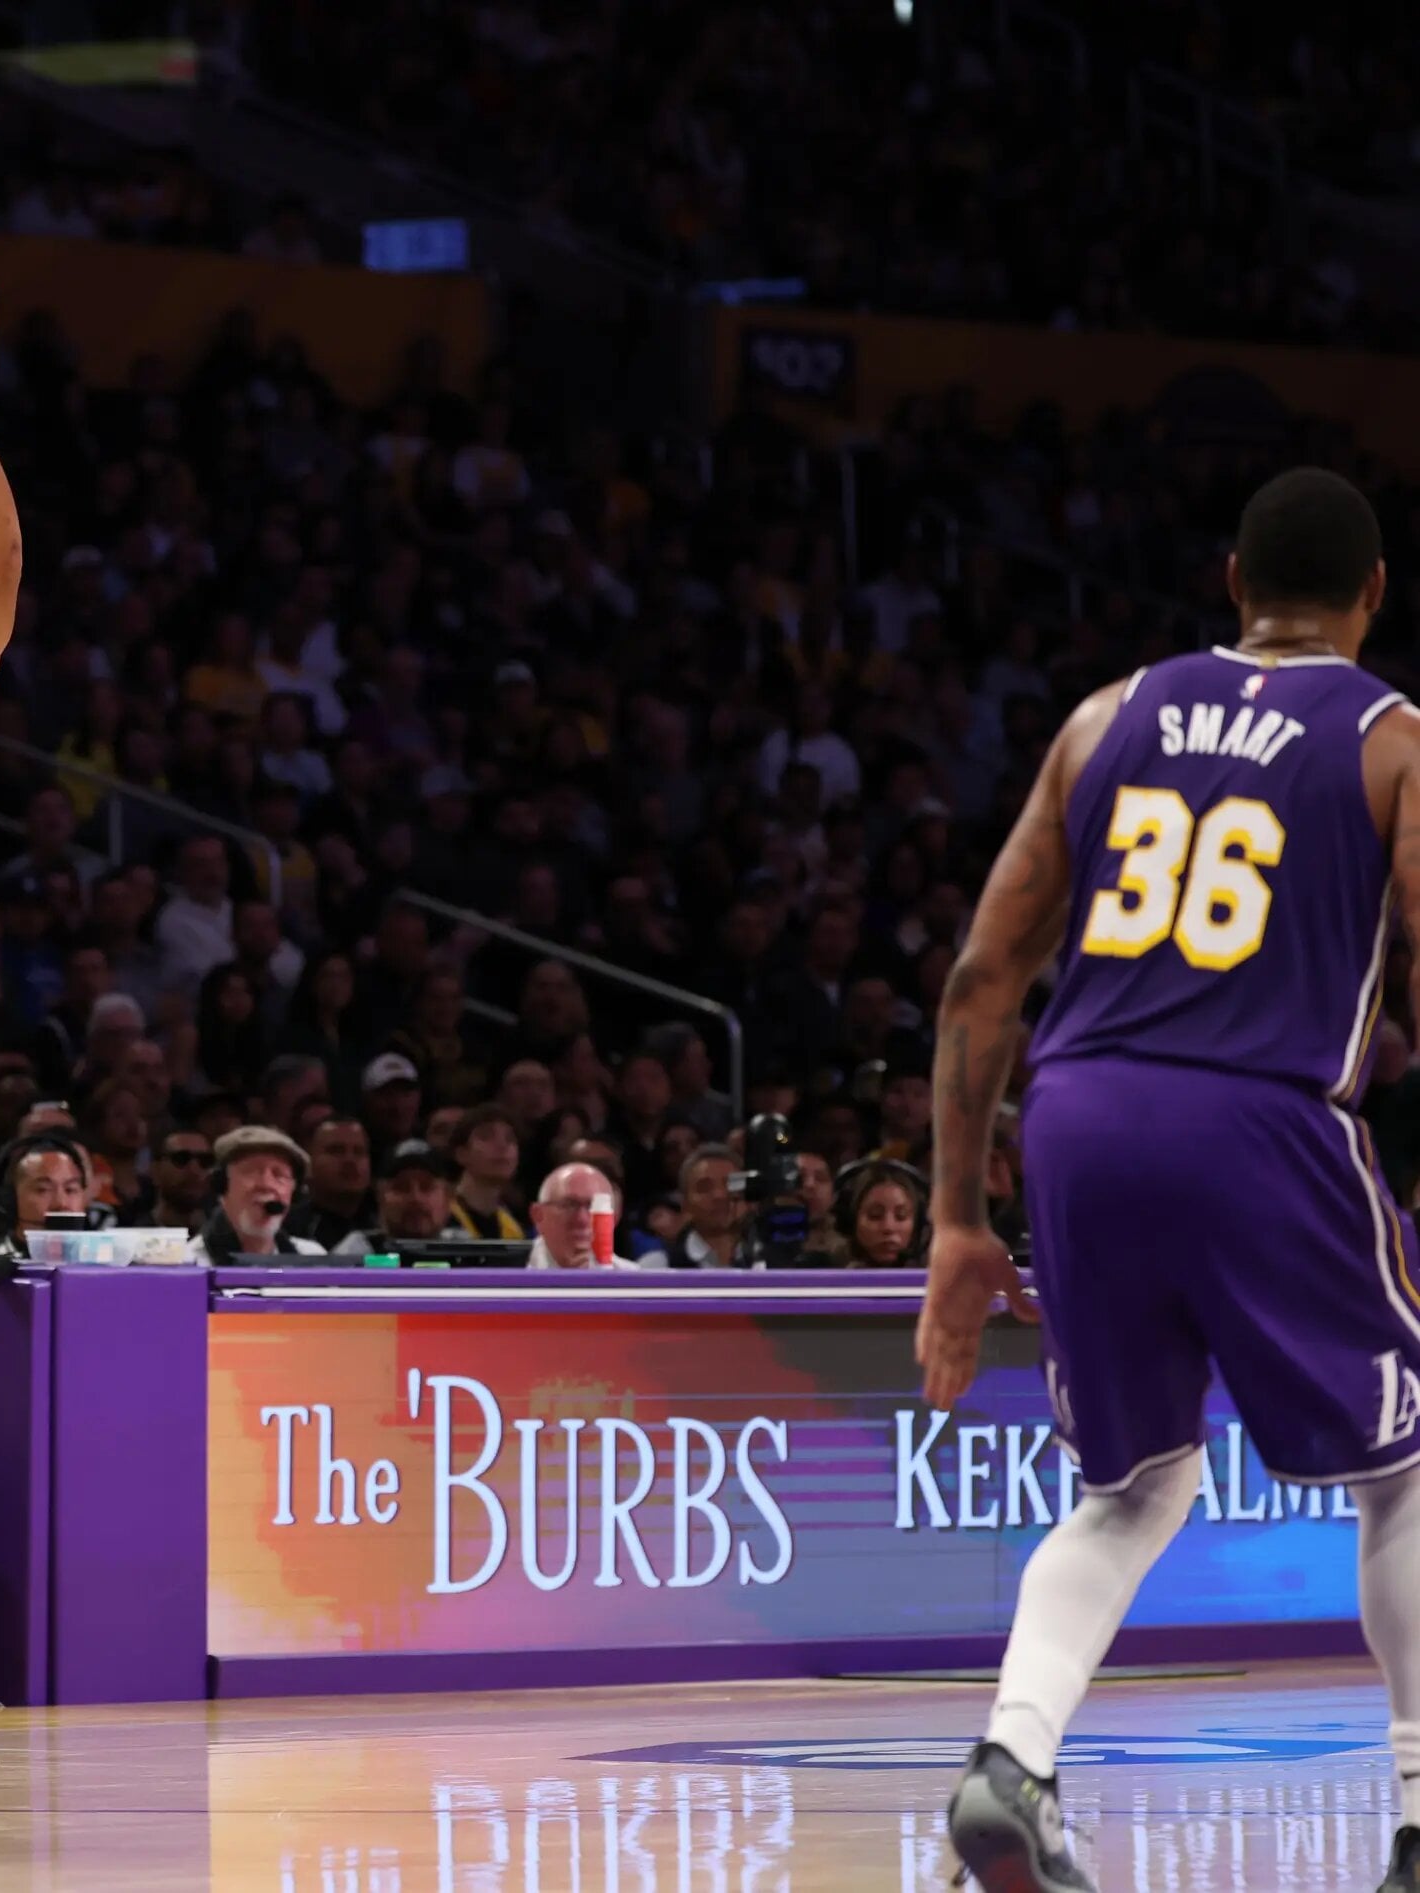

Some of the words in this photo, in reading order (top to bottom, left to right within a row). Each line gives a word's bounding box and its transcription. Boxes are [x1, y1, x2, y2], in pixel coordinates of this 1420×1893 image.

[1157, 702, 1307, 768] SMART
[1081, 785, 1287, 972] 36
[260, 1404, 399, 1525] The
[407, 1368, 794, 1594] 'BURBS
